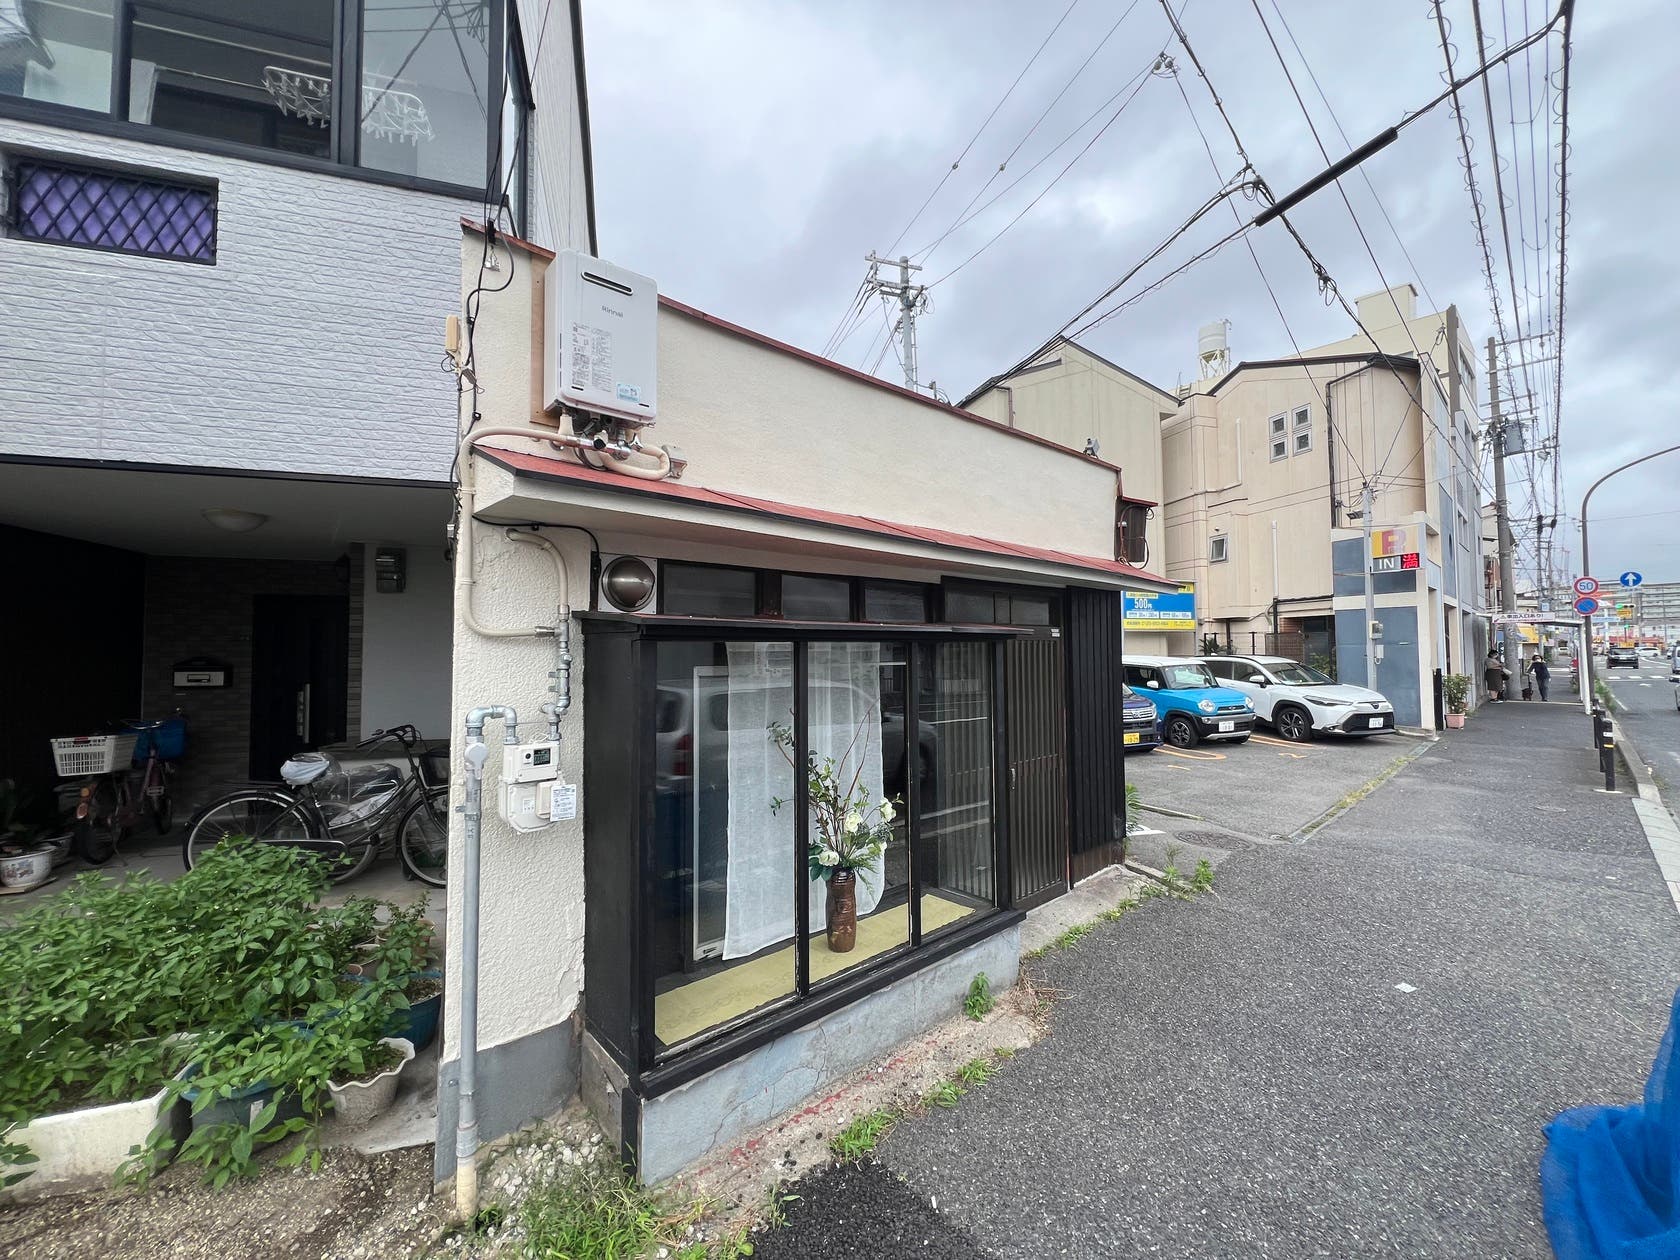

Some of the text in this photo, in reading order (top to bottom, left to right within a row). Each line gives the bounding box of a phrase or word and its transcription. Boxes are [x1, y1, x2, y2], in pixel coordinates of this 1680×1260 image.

[1379, 557, 1395, 570] IN
[1402, 553, 1419, 569] 満
[1579, 581, 1594, 591] 50
